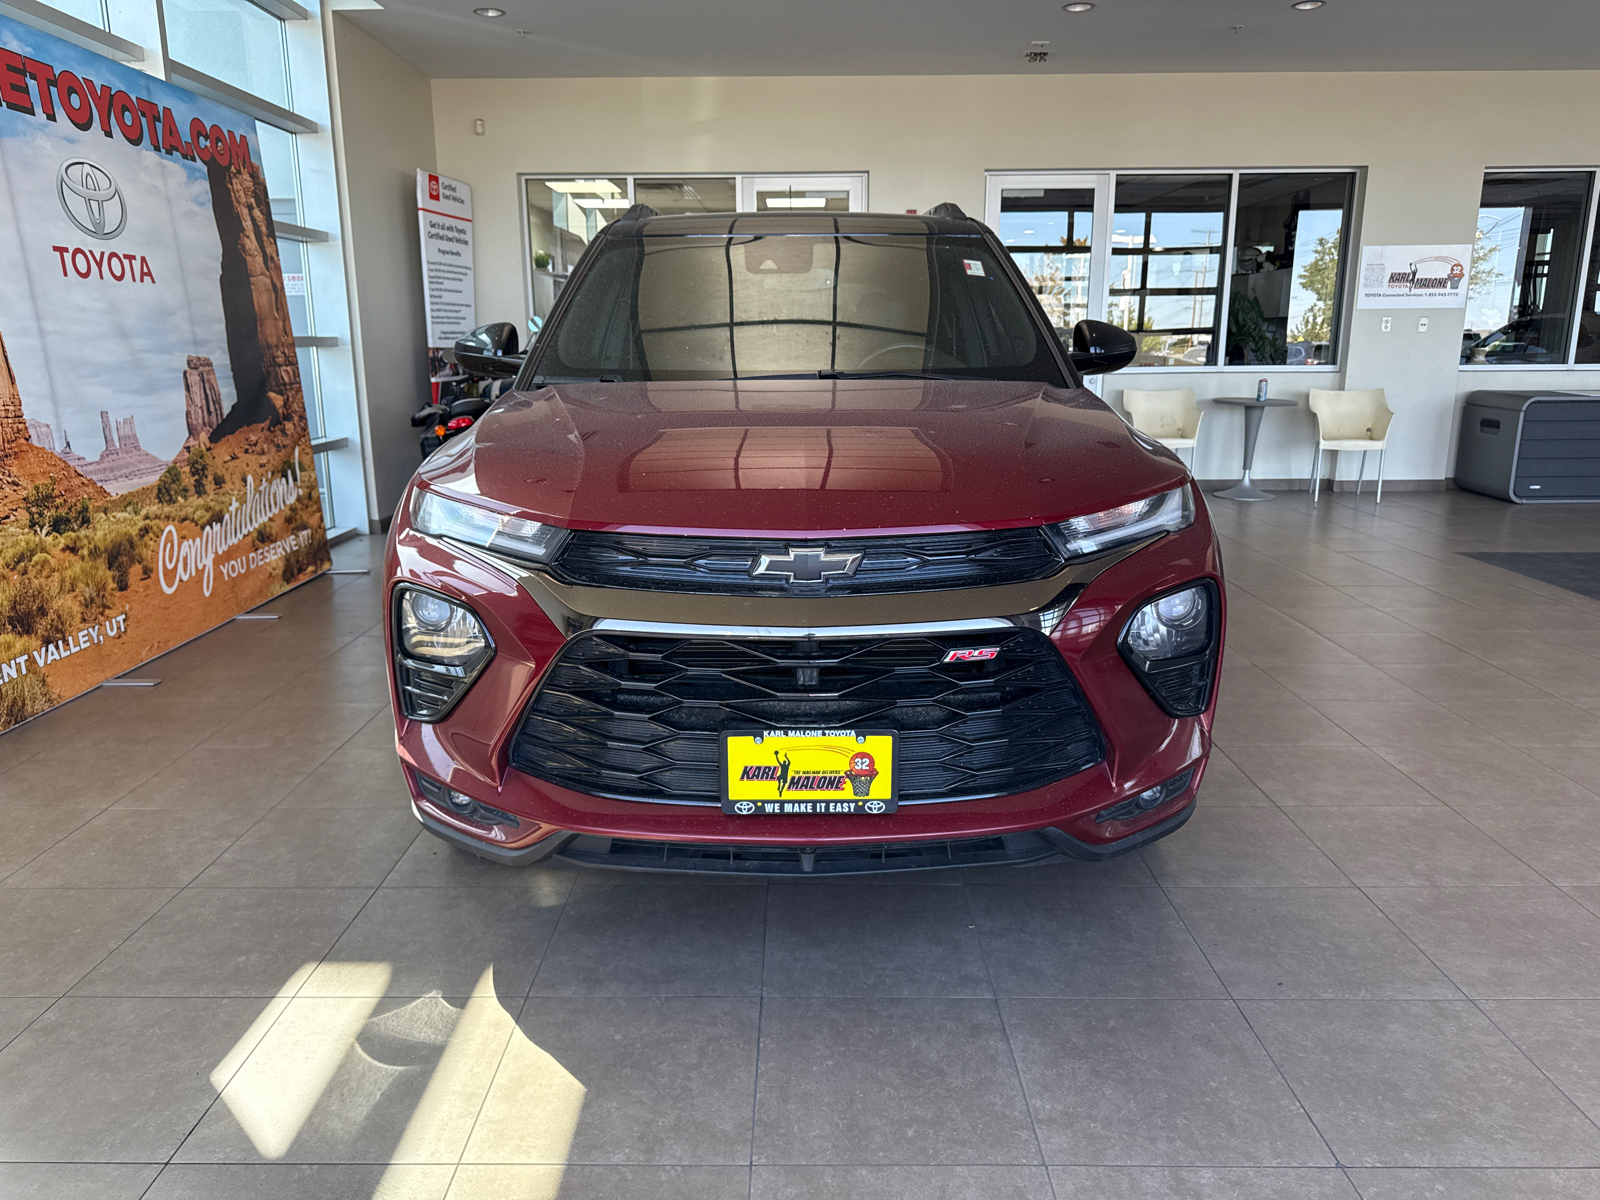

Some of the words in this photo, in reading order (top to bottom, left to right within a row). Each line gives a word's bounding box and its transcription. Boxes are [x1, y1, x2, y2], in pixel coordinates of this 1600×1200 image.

[441, 182, 456, 192] Certified
[442, 192, 450, 200] Used
[452, 195, 465, 204] Vehicles
[455, 226, 466, 235] Toyota
[428, 231, 444, 241] Certified
[445, 234, 454, 242] Used
[455, 236, 469, 246] Vehicles
[438, 248, 449, 256] Program
[52, 245, 156, 284] TOYOTA
[1388, 272, 1412, 283] KARL
[1413, 278, 1448, 289] MALONE
[158, 445, 303, 598] Congratulations!
[220, 556, 246, 581] YOU
[249, 534, 299, 568] DESERVE
[298, 529, 312, 548] IT!
[32, 625, 104, 668] VALLEY,
[105, 614, 126, 637] UT
[942, 647, 1000, 662] RS
[854, 758, 870, 770] 32
[739, 765, 779, 781] KARL
[786, 775, 846, 791] MALONE
[764, 803, 780, 813] WE
[784, 803, 813, 813] MAKE
[816, 803, 826, 813] IT
[829, 803, 856, 813] EASY
